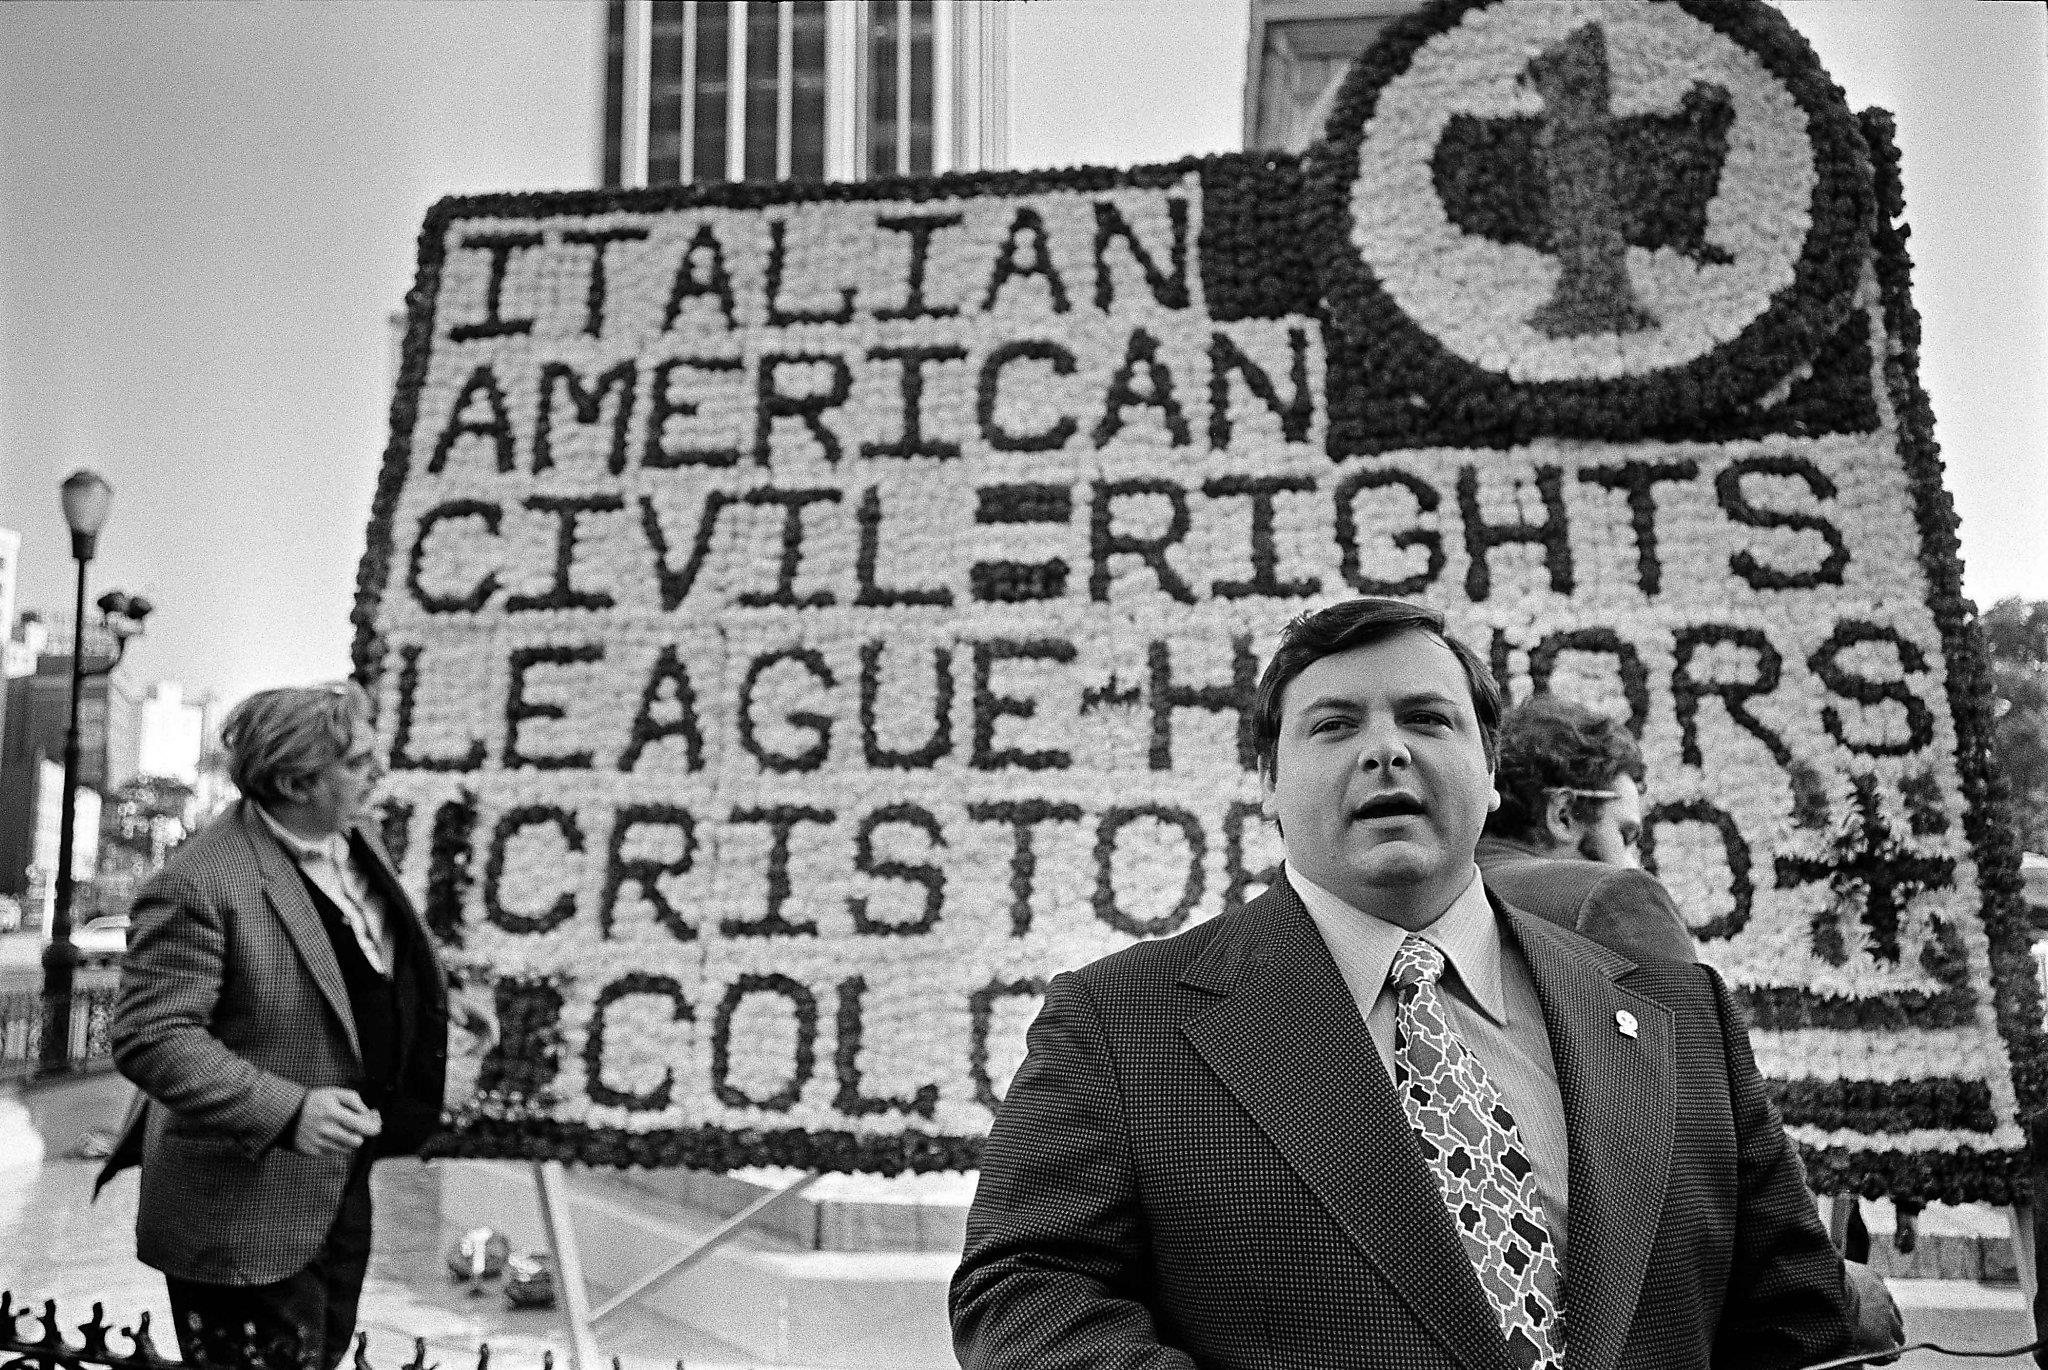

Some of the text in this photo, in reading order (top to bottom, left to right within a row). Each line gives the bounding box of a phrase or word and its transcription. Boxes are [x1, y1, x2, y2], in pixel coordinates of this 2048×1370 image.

[450, 198, 1189, 341] ITALIAN
[428, 325, 1314, 474] AMERICAN
[409, 457, 1850, 613] CIVIL RIGHTS
[390, 620, 1934, 772] LEAGUE HORS
